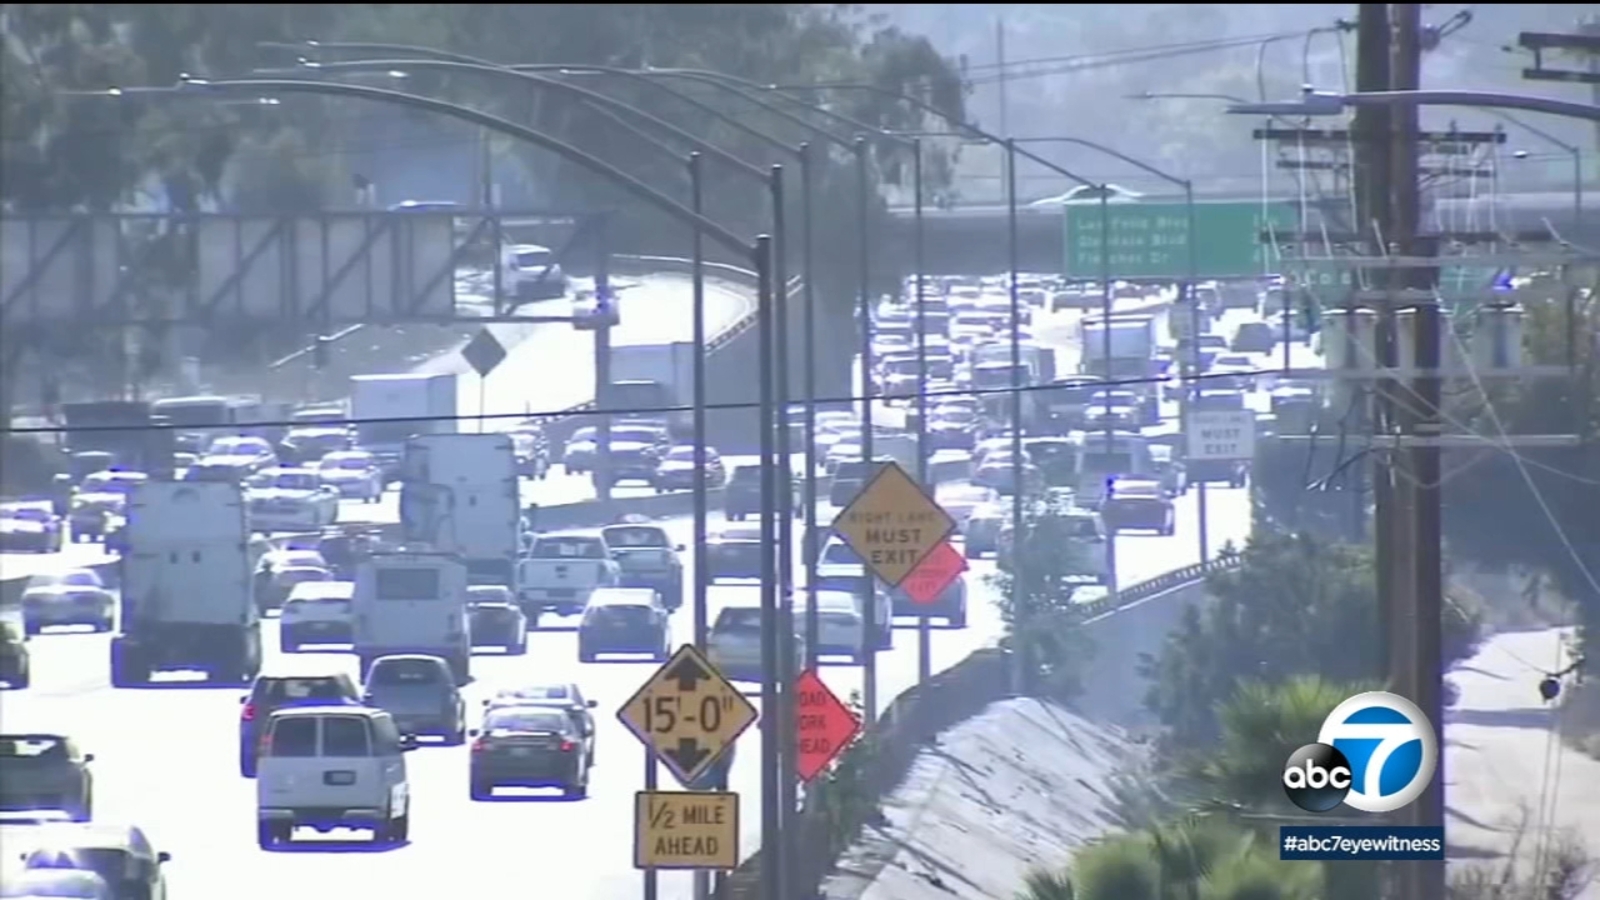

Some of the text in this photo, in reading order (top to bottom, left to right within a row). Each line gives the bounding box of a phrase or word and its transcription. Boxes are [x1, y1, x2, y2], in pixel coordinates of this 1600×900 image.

[1201, 428, 1240, 440] MUST
[1204, 443, 1238, 455] EXIT
[865, 528, 922, 544] MUST
[871, 550, 918, 564] EXIT
[799, 691, 827, 707] OAD
[799, 714, 827, 731] ORK
[798, 738, 831, 755] EAD
[682, 805, 726, 825] MILE
[654, 836, 719, 856] AHEAD
